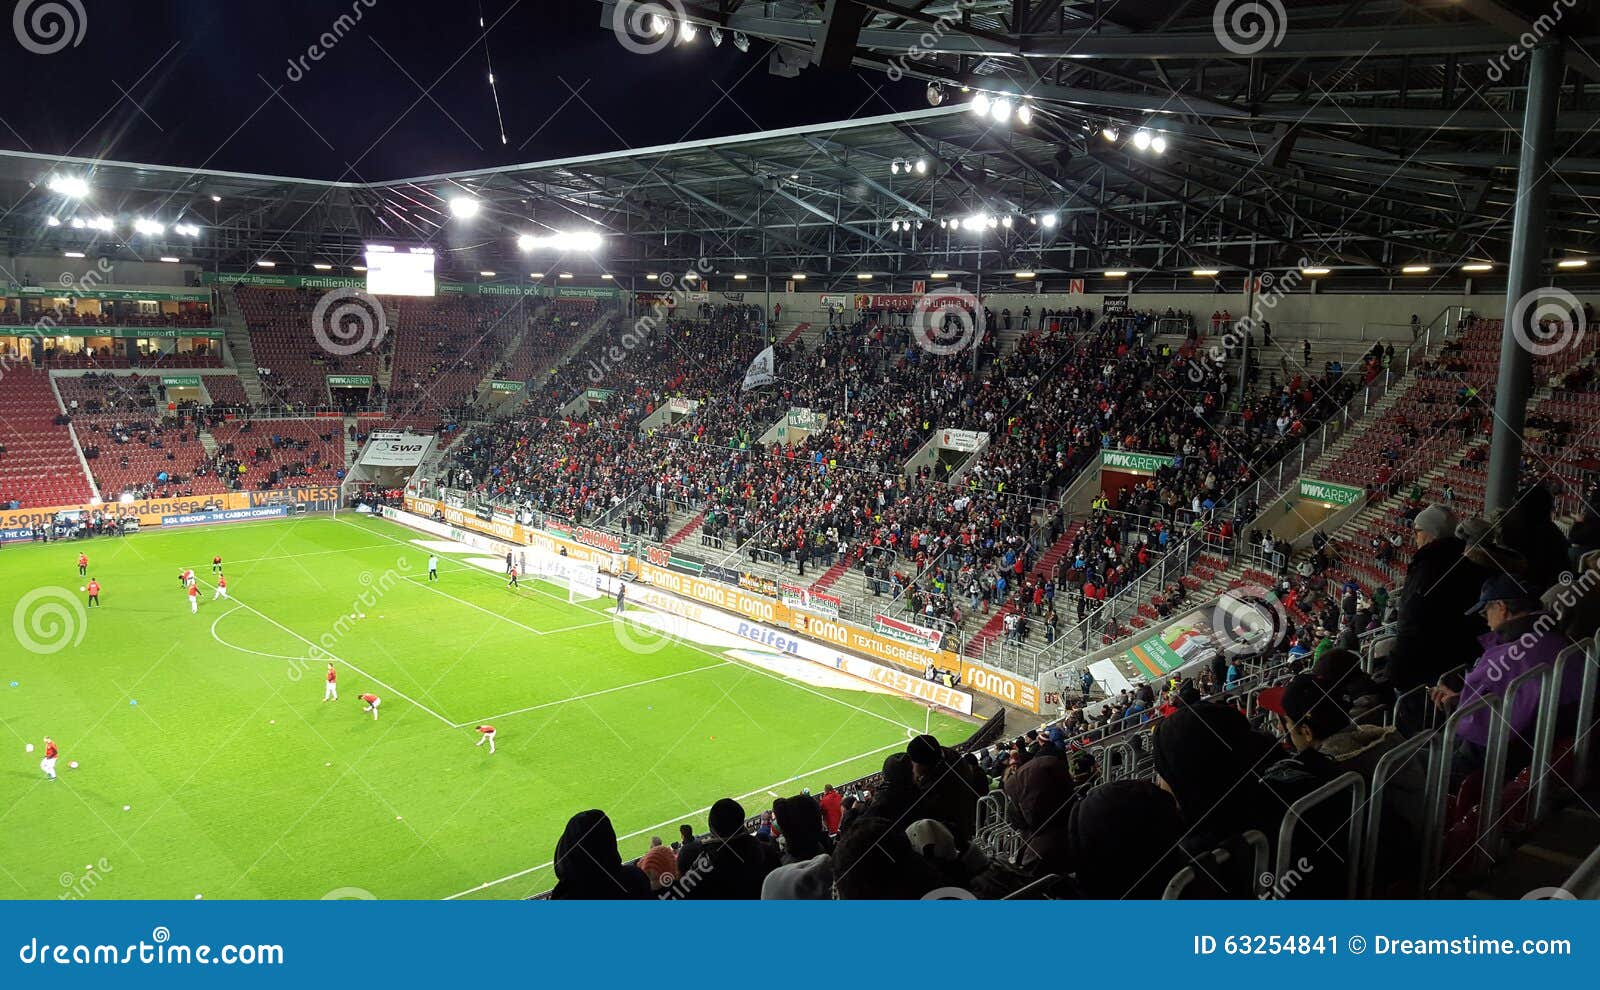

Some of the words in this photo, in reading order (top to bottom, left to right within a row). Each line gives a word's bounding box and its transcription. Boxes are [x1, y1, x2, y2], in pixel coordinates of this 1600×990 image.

[301, 277, 366, 289] Familienbloc
[914, 280, 924, 293] M
[1071, 279, 1083, 293] N
[478, 284, 540, 296] Familienbock
[390, 443, 423, 453] swa
[225, 510, 251, 519] CARBON
[252, 507, 282, 517] COMPANY
[652, 571, 681, 591] roma
[692, 582, 724, 604] roma
[739, 594, 773, 620] roma
[738, 622, 799, 654] Reifen
[808, 617, 848, 645] roma
[853, 633, 934, 668] TEXTILSCREENS
[968, 667, 1016, 701] roma
